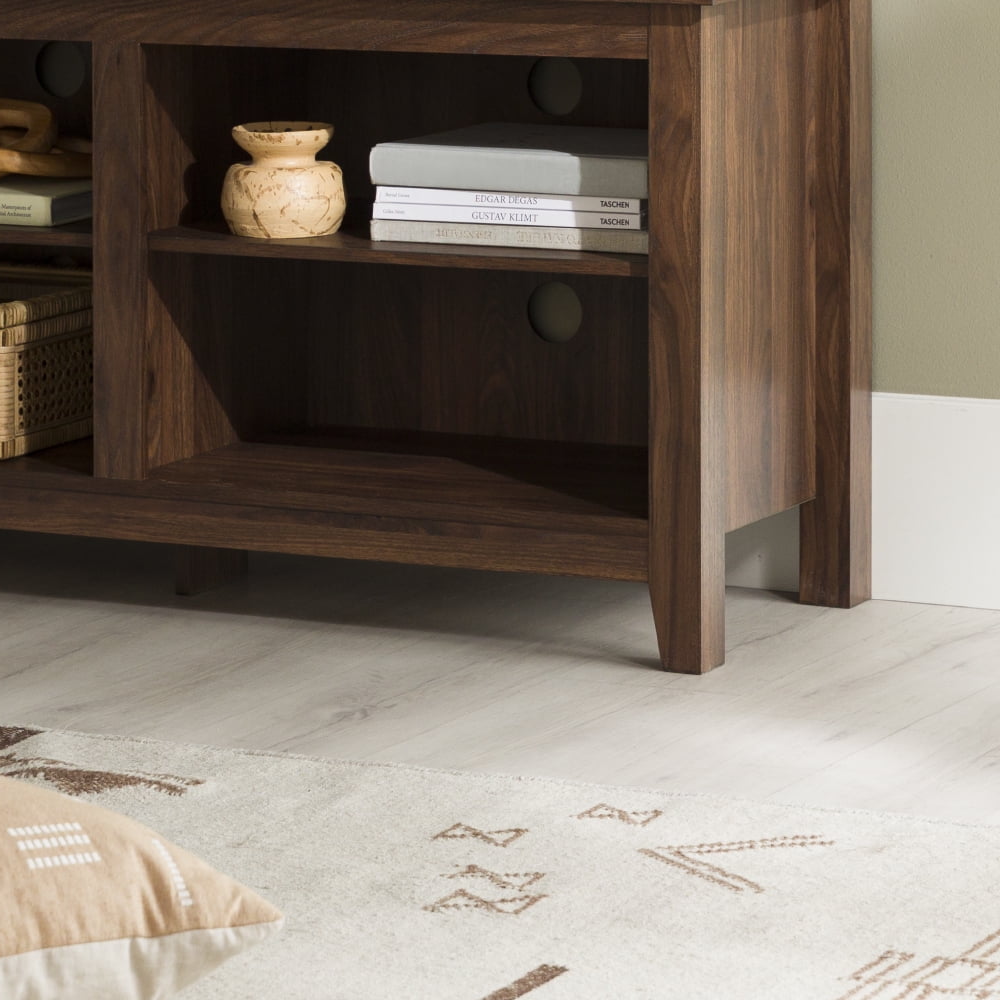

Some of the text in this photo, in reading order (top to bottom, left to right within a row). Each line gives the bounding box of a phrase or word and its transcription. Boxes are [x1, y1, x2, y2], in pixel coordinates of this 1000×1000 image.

[475, 194, 538, 205] EDGAR DEGAS
[600, 200, 630, 209] TASCHEN
[472, 211, 538, 222] GUSTAV KLIMT
[600, 217, 630, 226] TASCHEN
